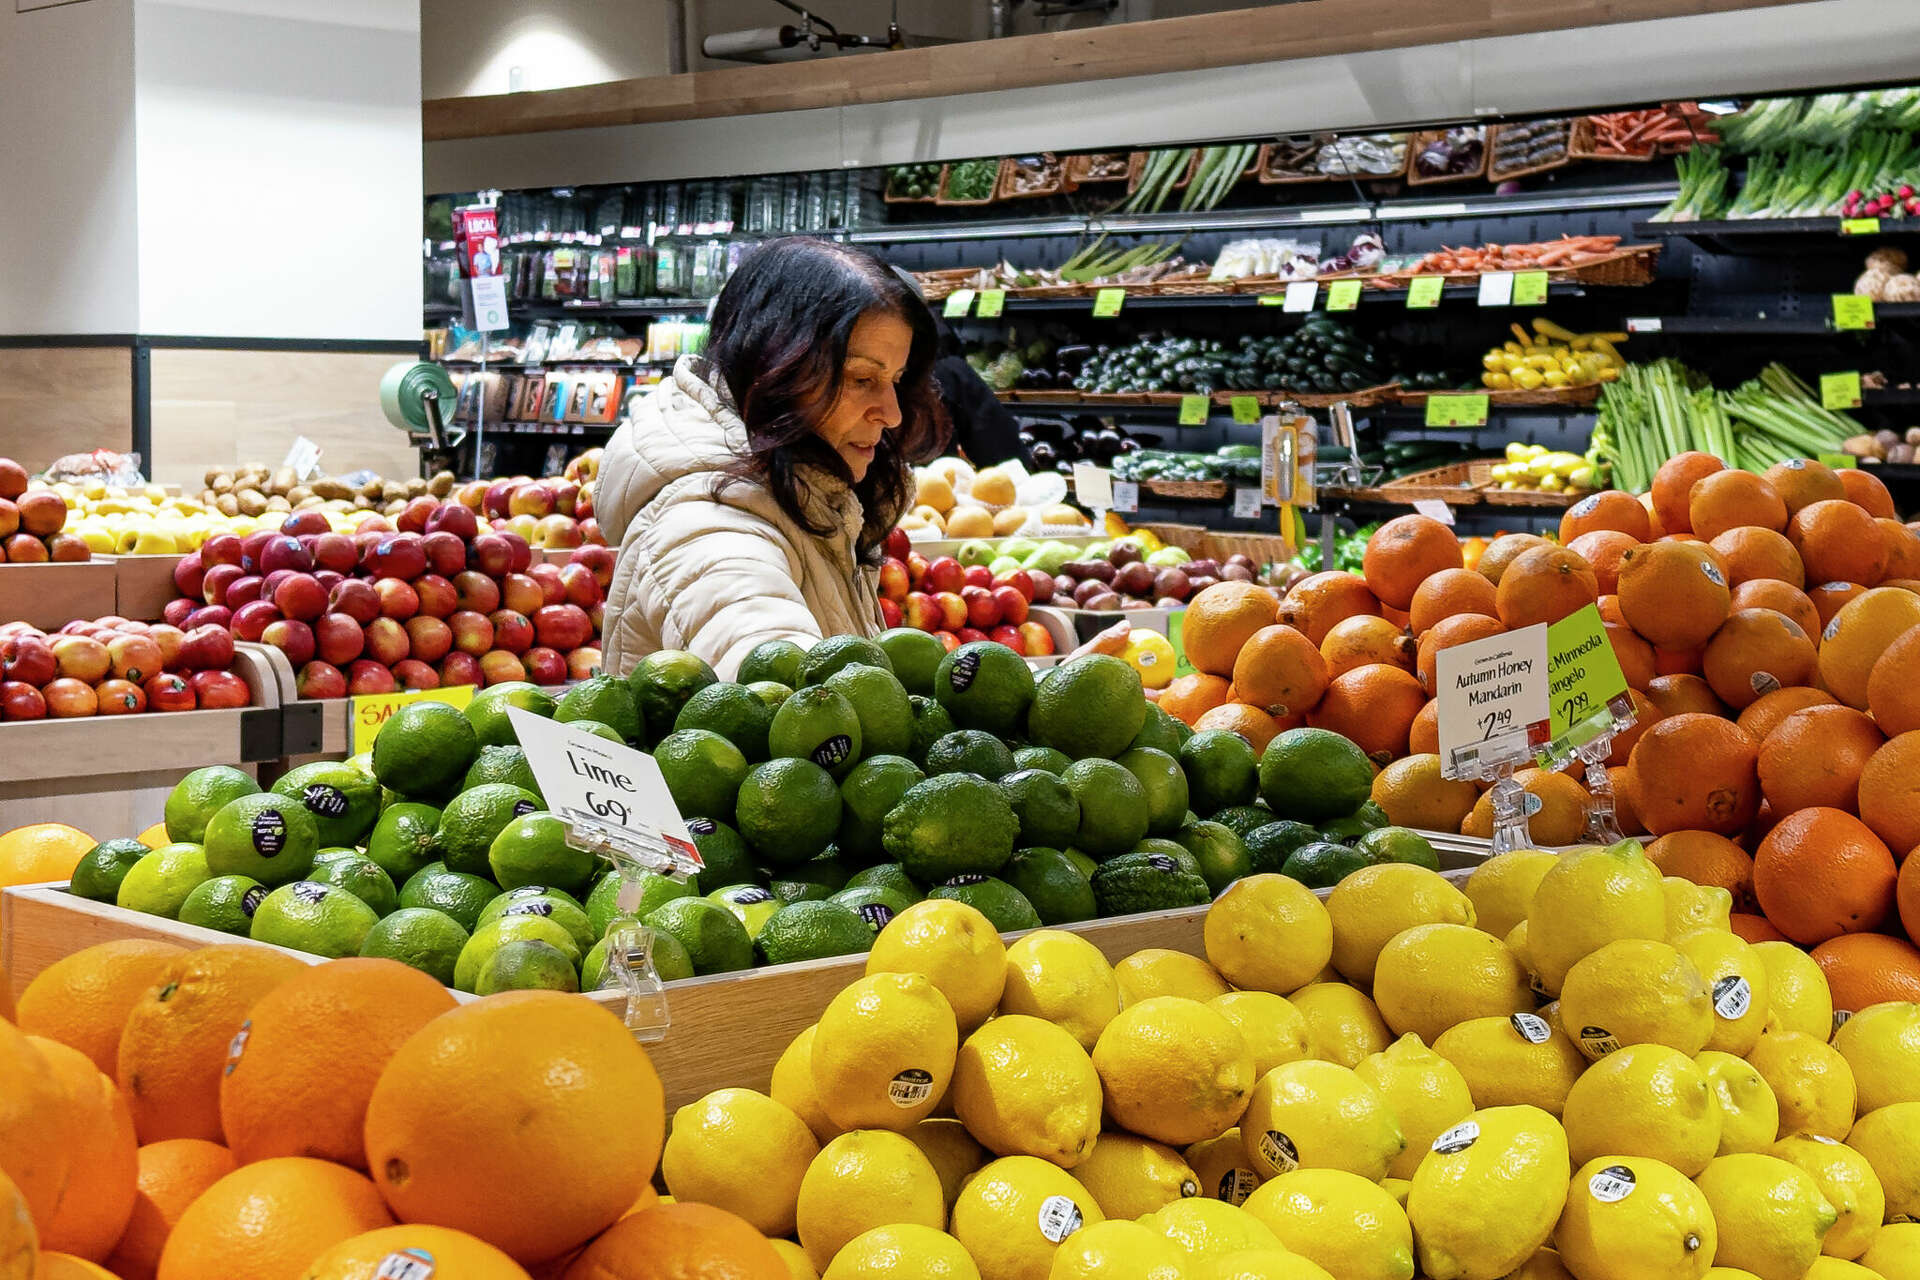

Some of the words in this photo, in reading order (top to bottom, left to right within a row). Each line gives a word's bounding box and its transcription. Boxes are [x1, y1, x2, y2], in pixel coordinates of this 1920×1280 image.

[468, 218, 495, 232] LOCAL
[1553, 633, 1603, 669] Minneola
[1455, 667, 1496, 689] Autumn
[1497, 659, 1533, 680] Honey
[1548, 666, 1586, 698] angelo
[1468, 681, 1522, 707] Mandarin
[566, 750, 637, 793] Lime
